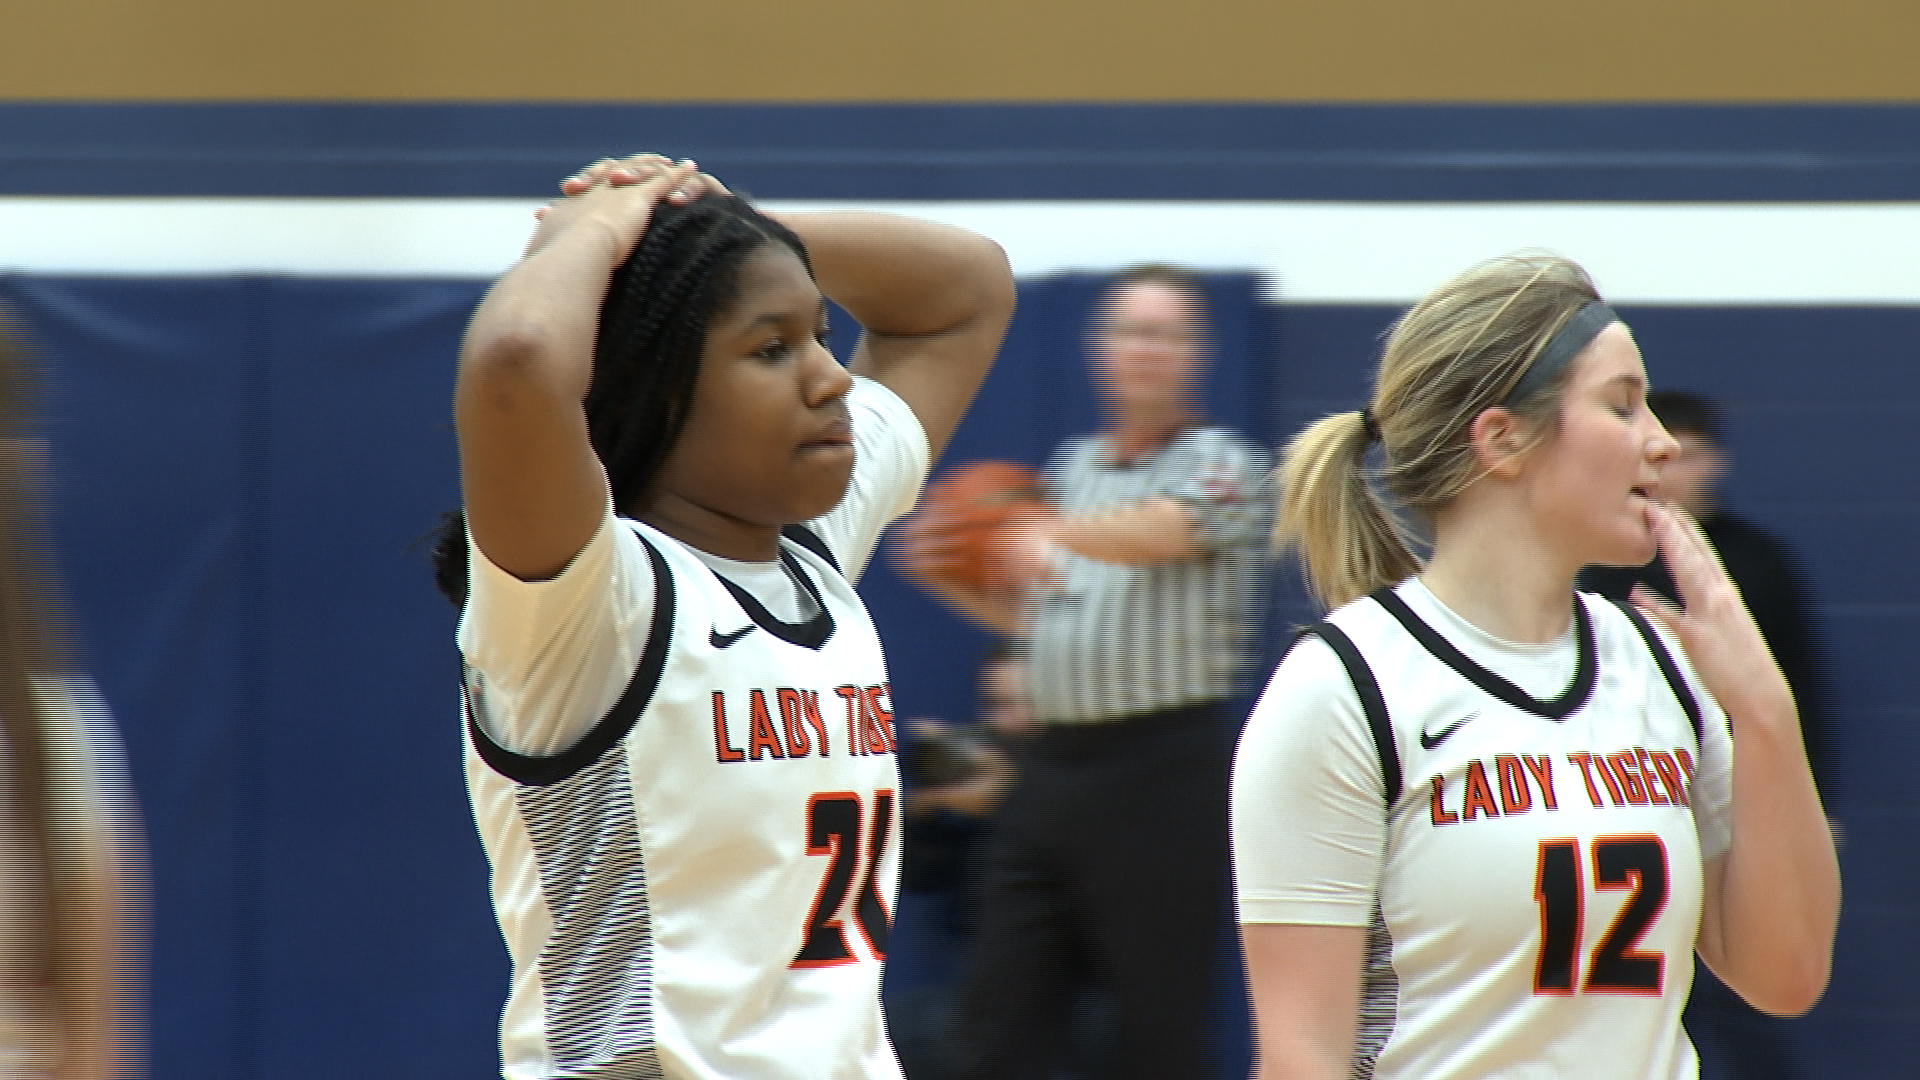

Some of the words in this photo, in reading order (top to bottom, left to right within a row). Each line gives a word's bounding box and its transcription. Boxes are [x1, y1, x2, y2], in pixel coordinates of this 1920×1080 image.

[711, 687, 830, 762] LADY
[834, 683, 899, 757] TIGE
[1431, 754, 1559, 825] LADY
[1533, 833, 1671, 997] 12
